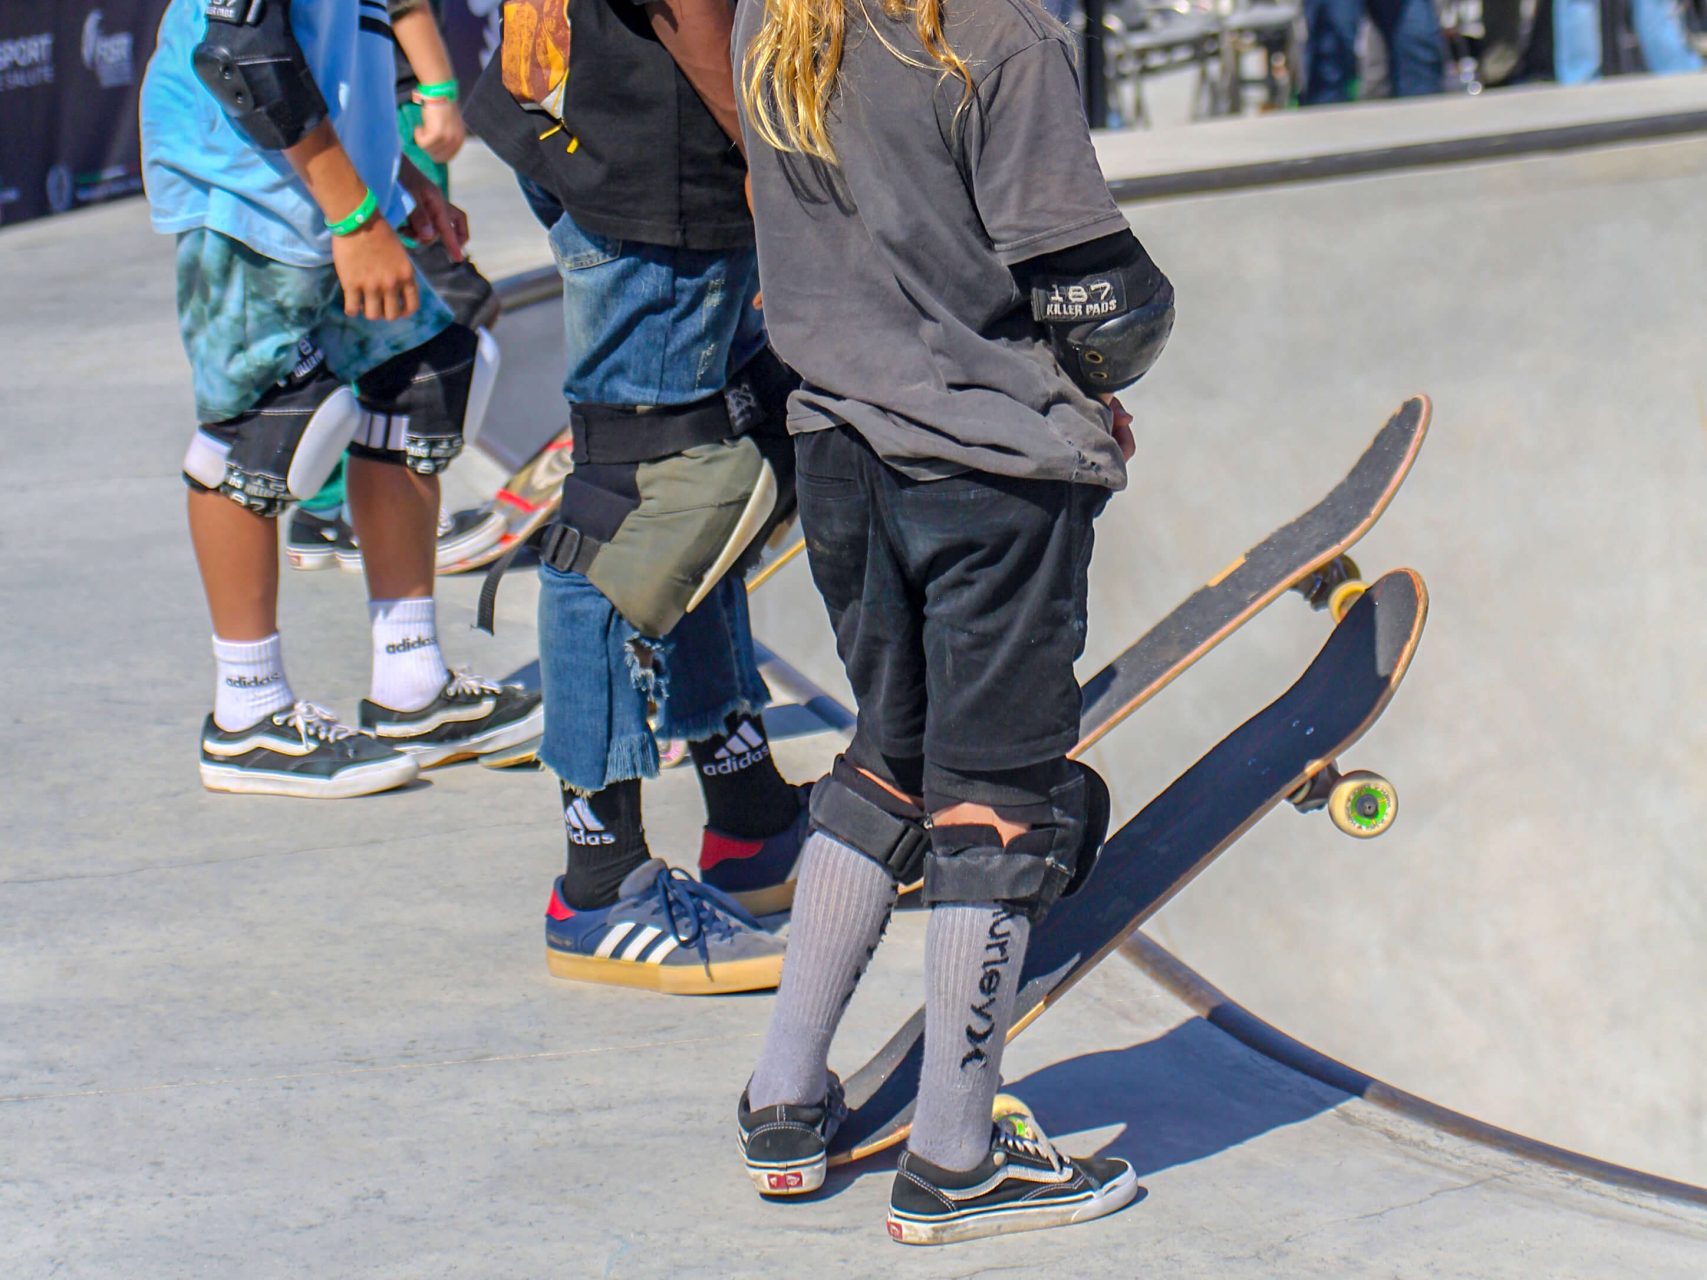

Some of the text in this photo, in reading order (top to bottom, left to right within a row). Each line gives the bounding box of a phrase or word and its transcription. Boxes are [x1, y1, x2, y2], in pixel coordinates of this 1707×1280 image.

[1050, 281, 1111, 303] 187
[1045, 298, 1118, 317] KILLER PADS
[567, 824, 616, 846] idas
